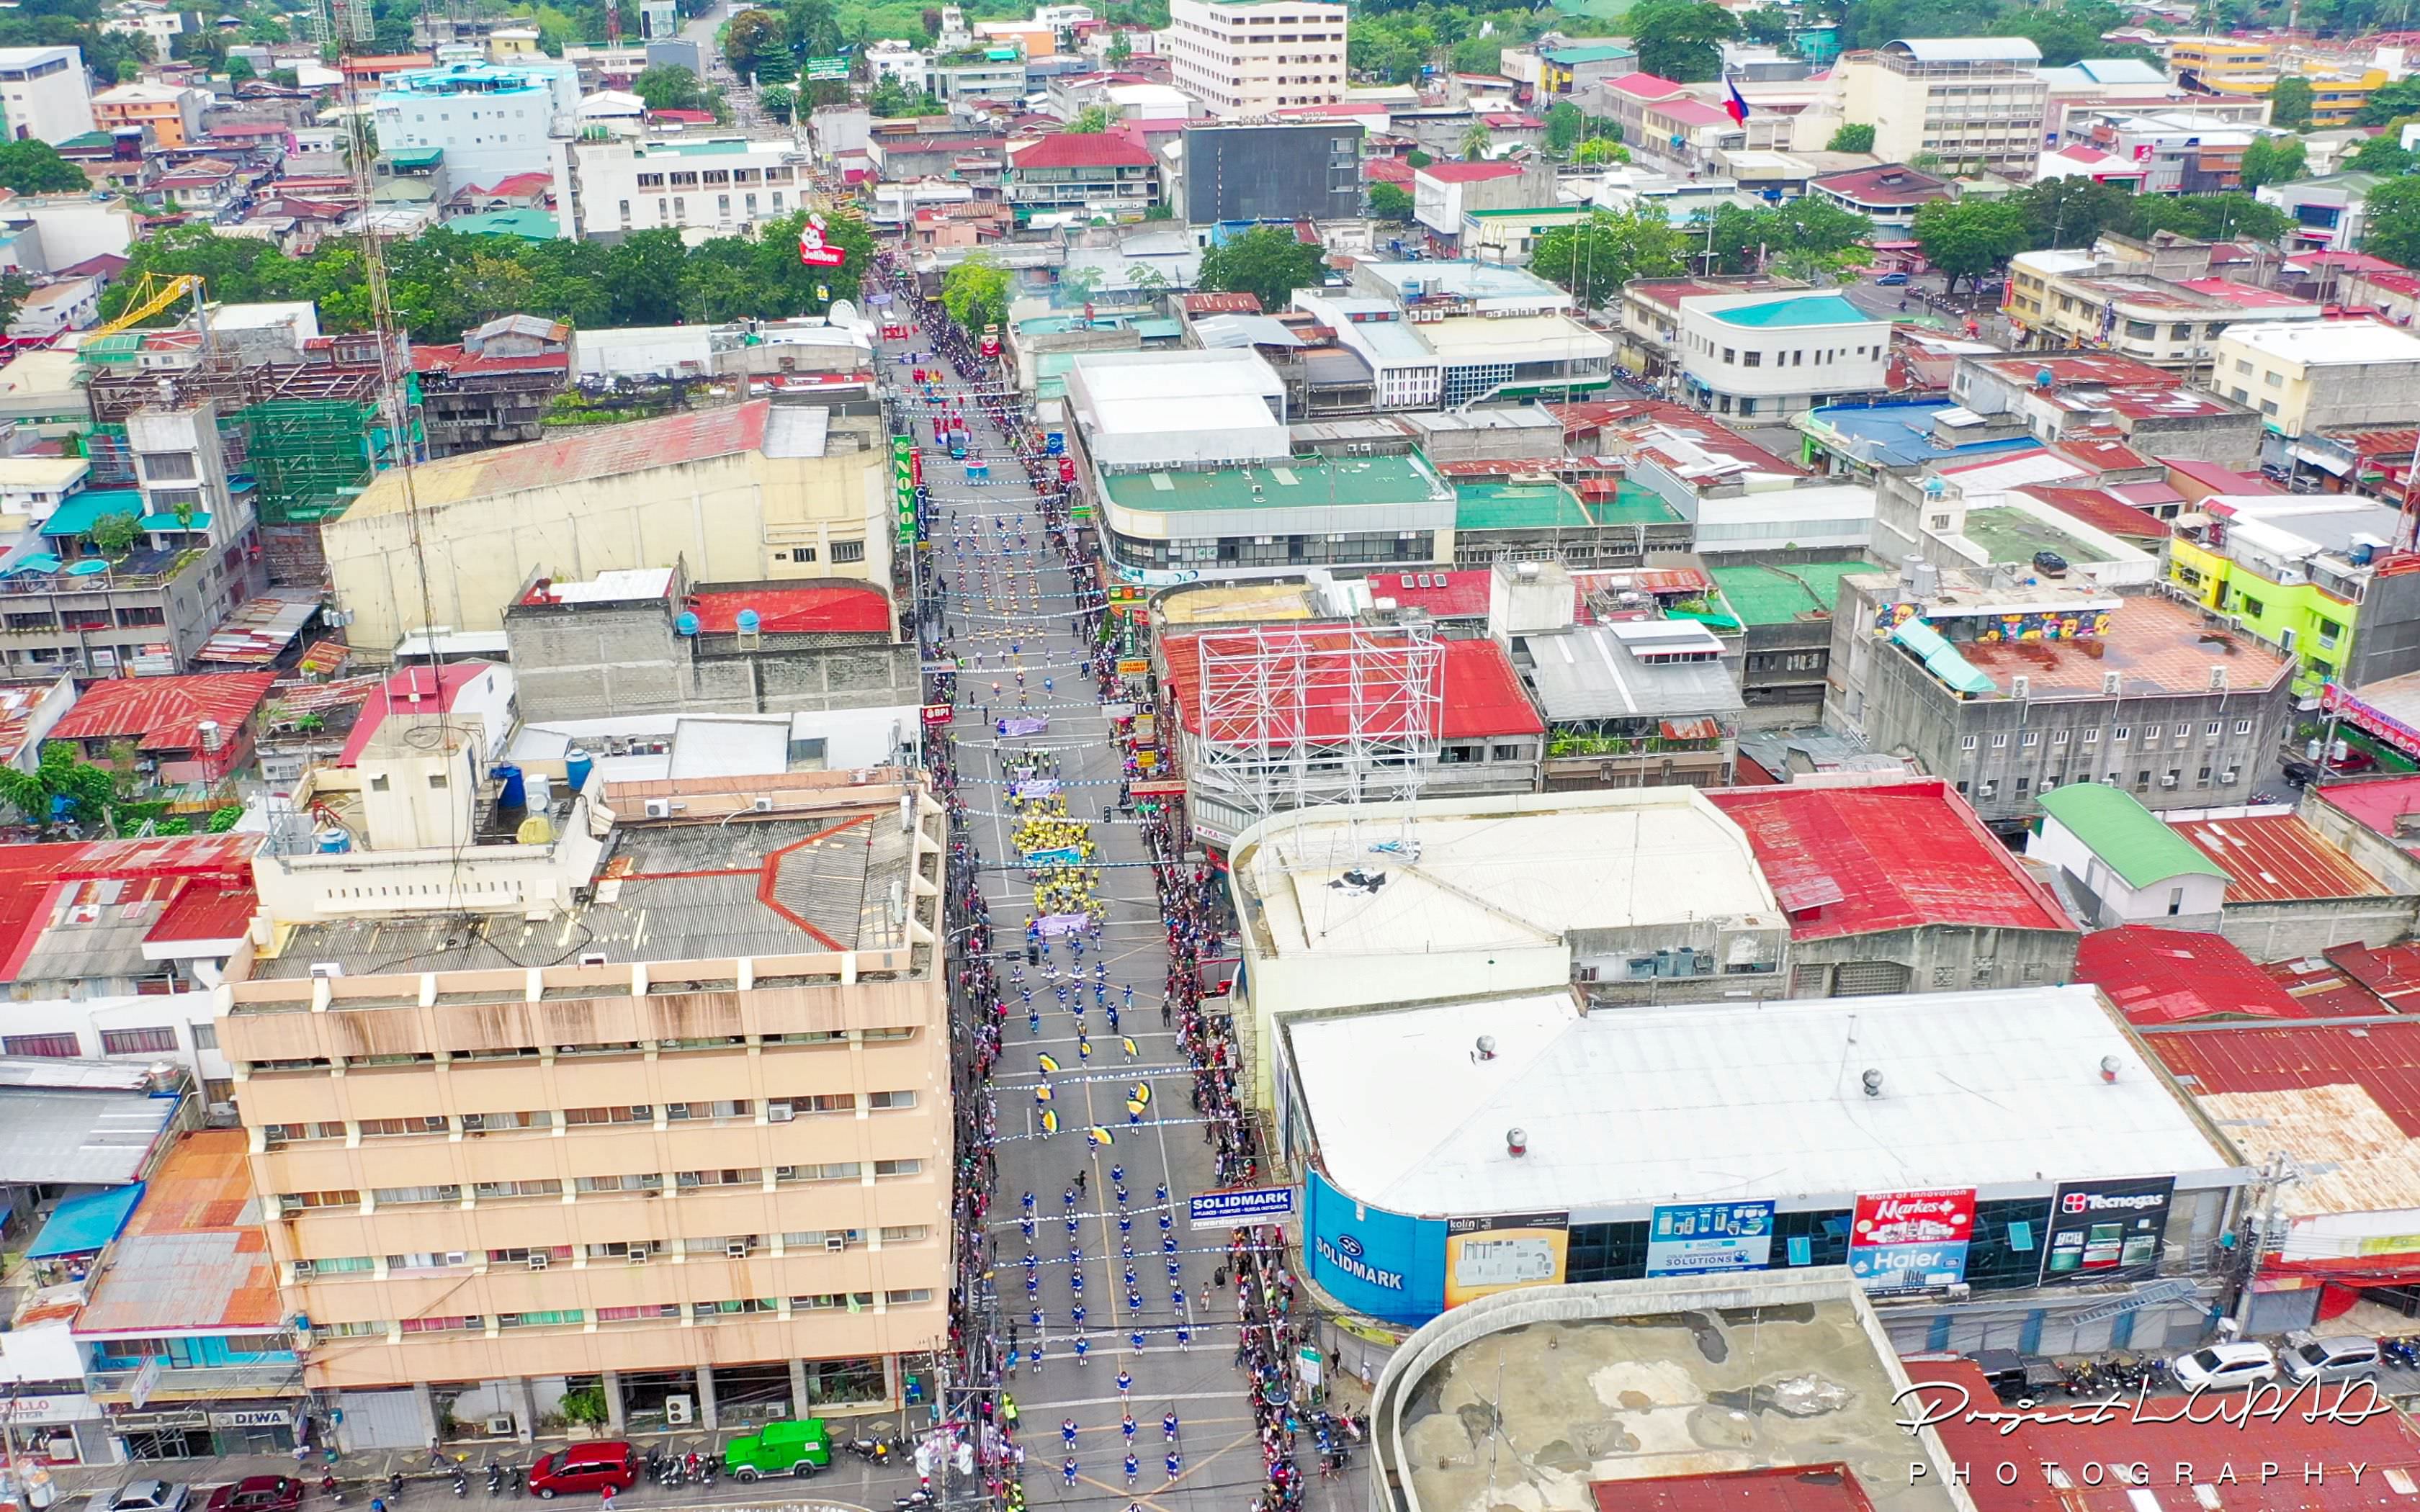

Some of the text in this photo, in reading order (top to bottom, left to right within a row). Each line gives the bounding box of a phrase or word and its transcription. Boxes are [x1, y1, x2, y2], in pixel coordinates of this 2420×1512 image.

[803, 249, 838, 262] Jollibee
[896, 460, 914, 525] NOVO
[915, 488, 927, 540] CEBUANA
[934, 708, 949, 716] BPI
[1204, 829, 1219, 840] JKA
[1193, 1192, 1289, 1210] SOLIDMARK
[2087, 1194, 2164, 1210] Tecnogas
[1875, 1200, 1939, 1220] Markes
[1450, 1219, 1475, 1229] kolin
[1316, 1236, 1402, 1290] SOLIDMARK
[1666, 1256, 1732, 1266] SOLUTIONS
[1873, 1250, 1941, 1270] Haier
[235, 1412, 282, 1424] DIWA
